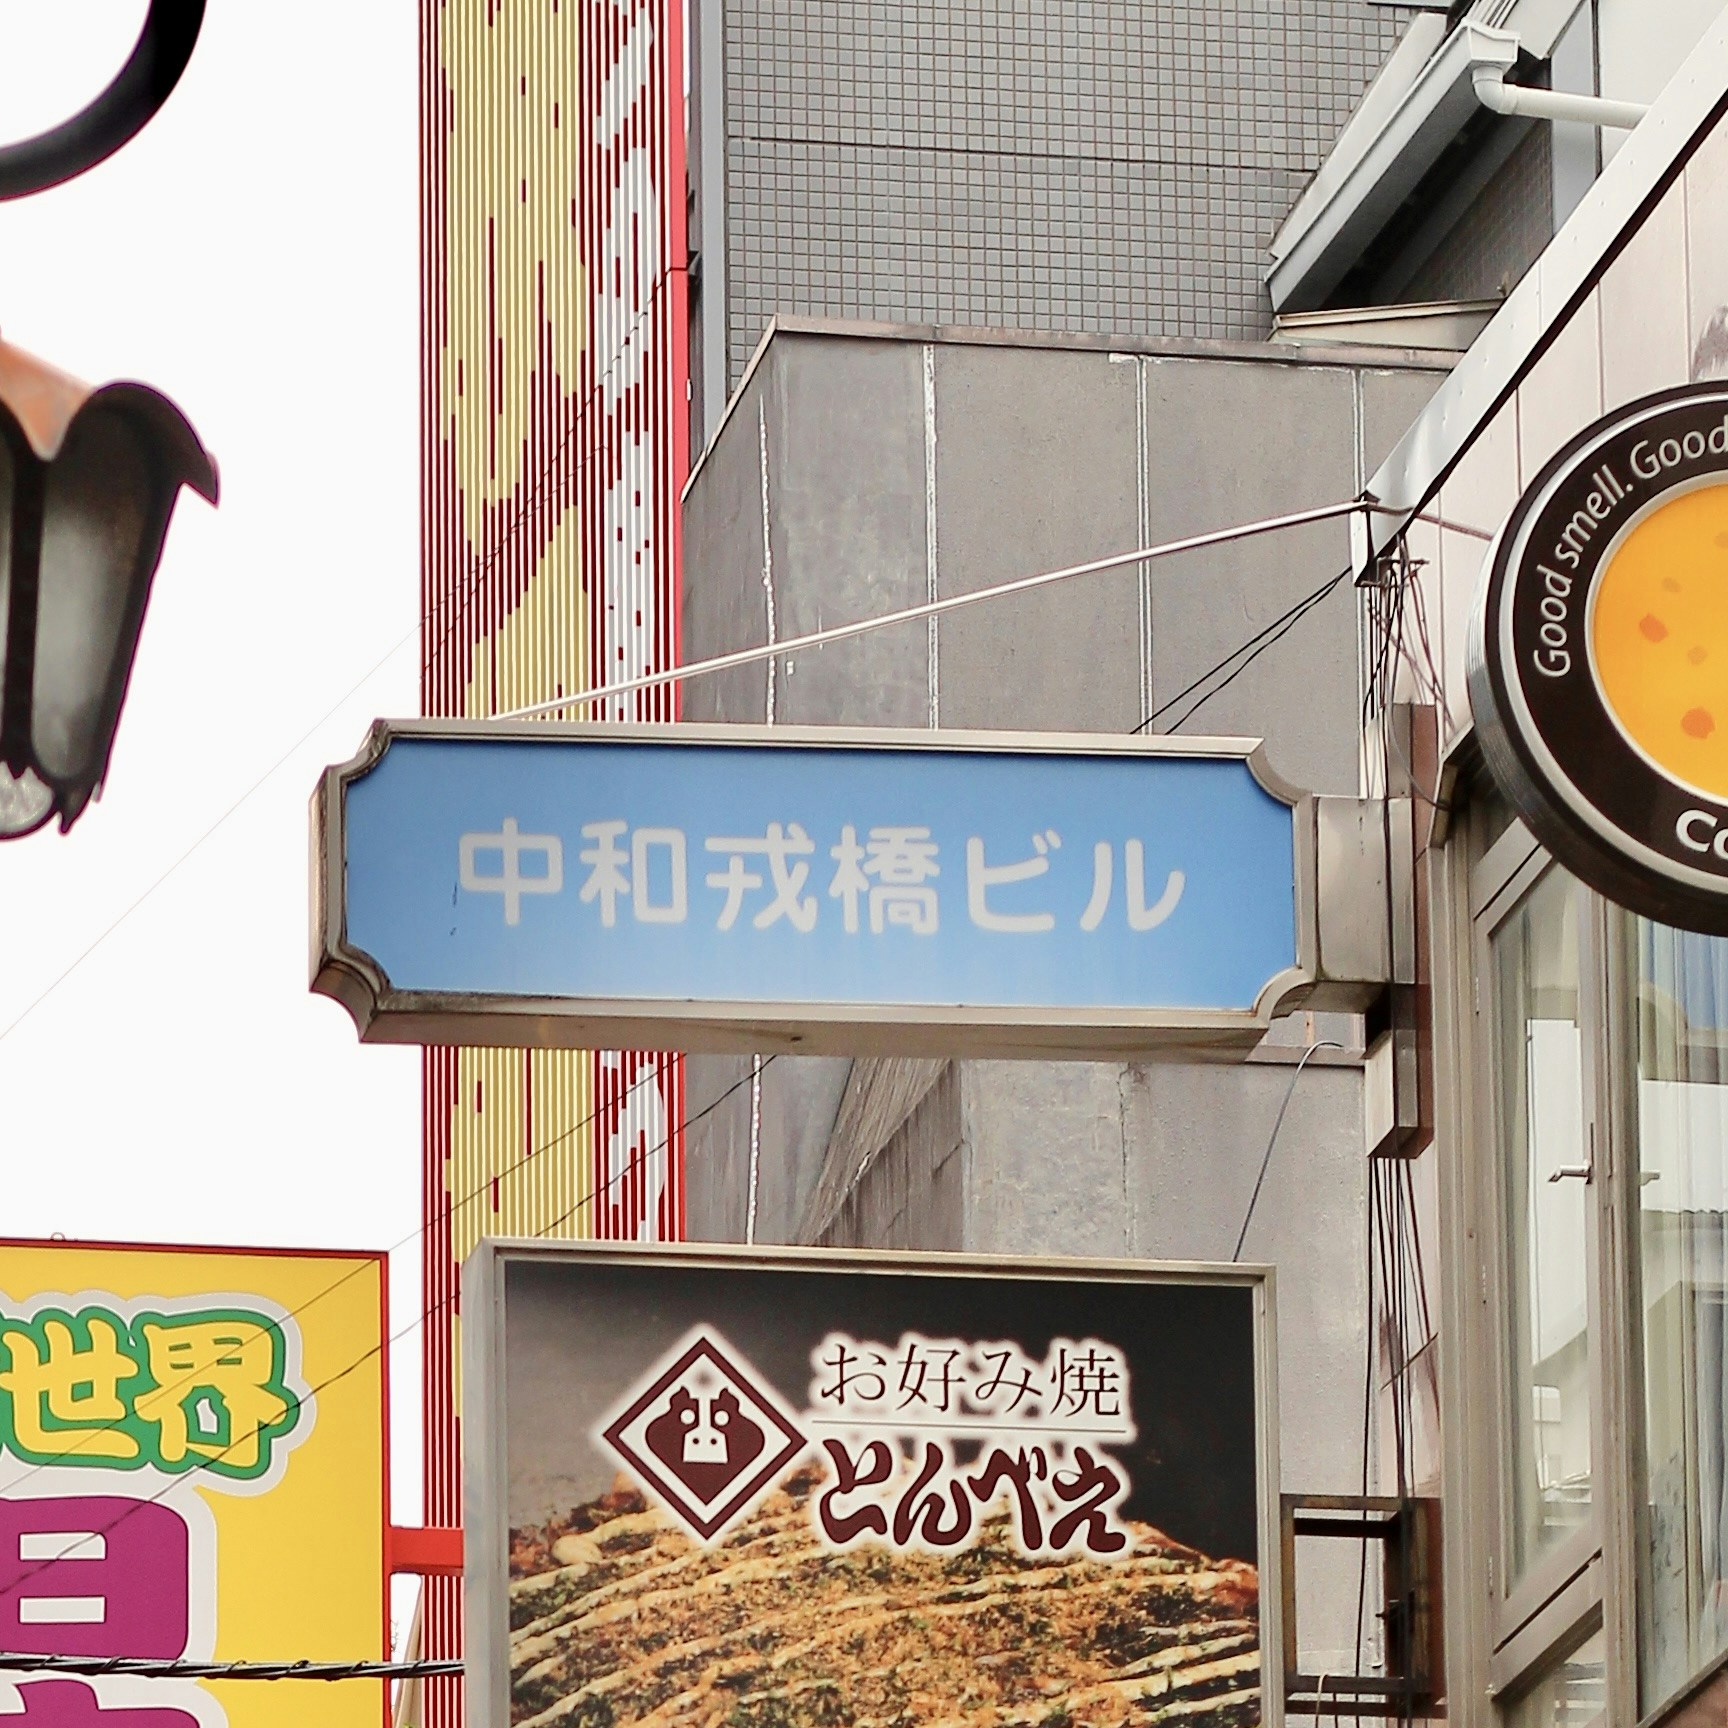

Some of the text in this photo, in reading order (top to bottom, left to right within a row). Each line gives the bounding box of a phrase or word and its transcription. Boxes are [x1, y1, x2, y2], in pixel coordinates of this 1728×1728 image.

[1534, 564, 1572, 678] Good
[1555, 464, 1634, 569] smell.
[457, 817, 1185, 938] 中和戎橋ビル
[817, 1344, 1124, 1418] お好み焼
[817, 1438, 1129, 1554] とんべえ
